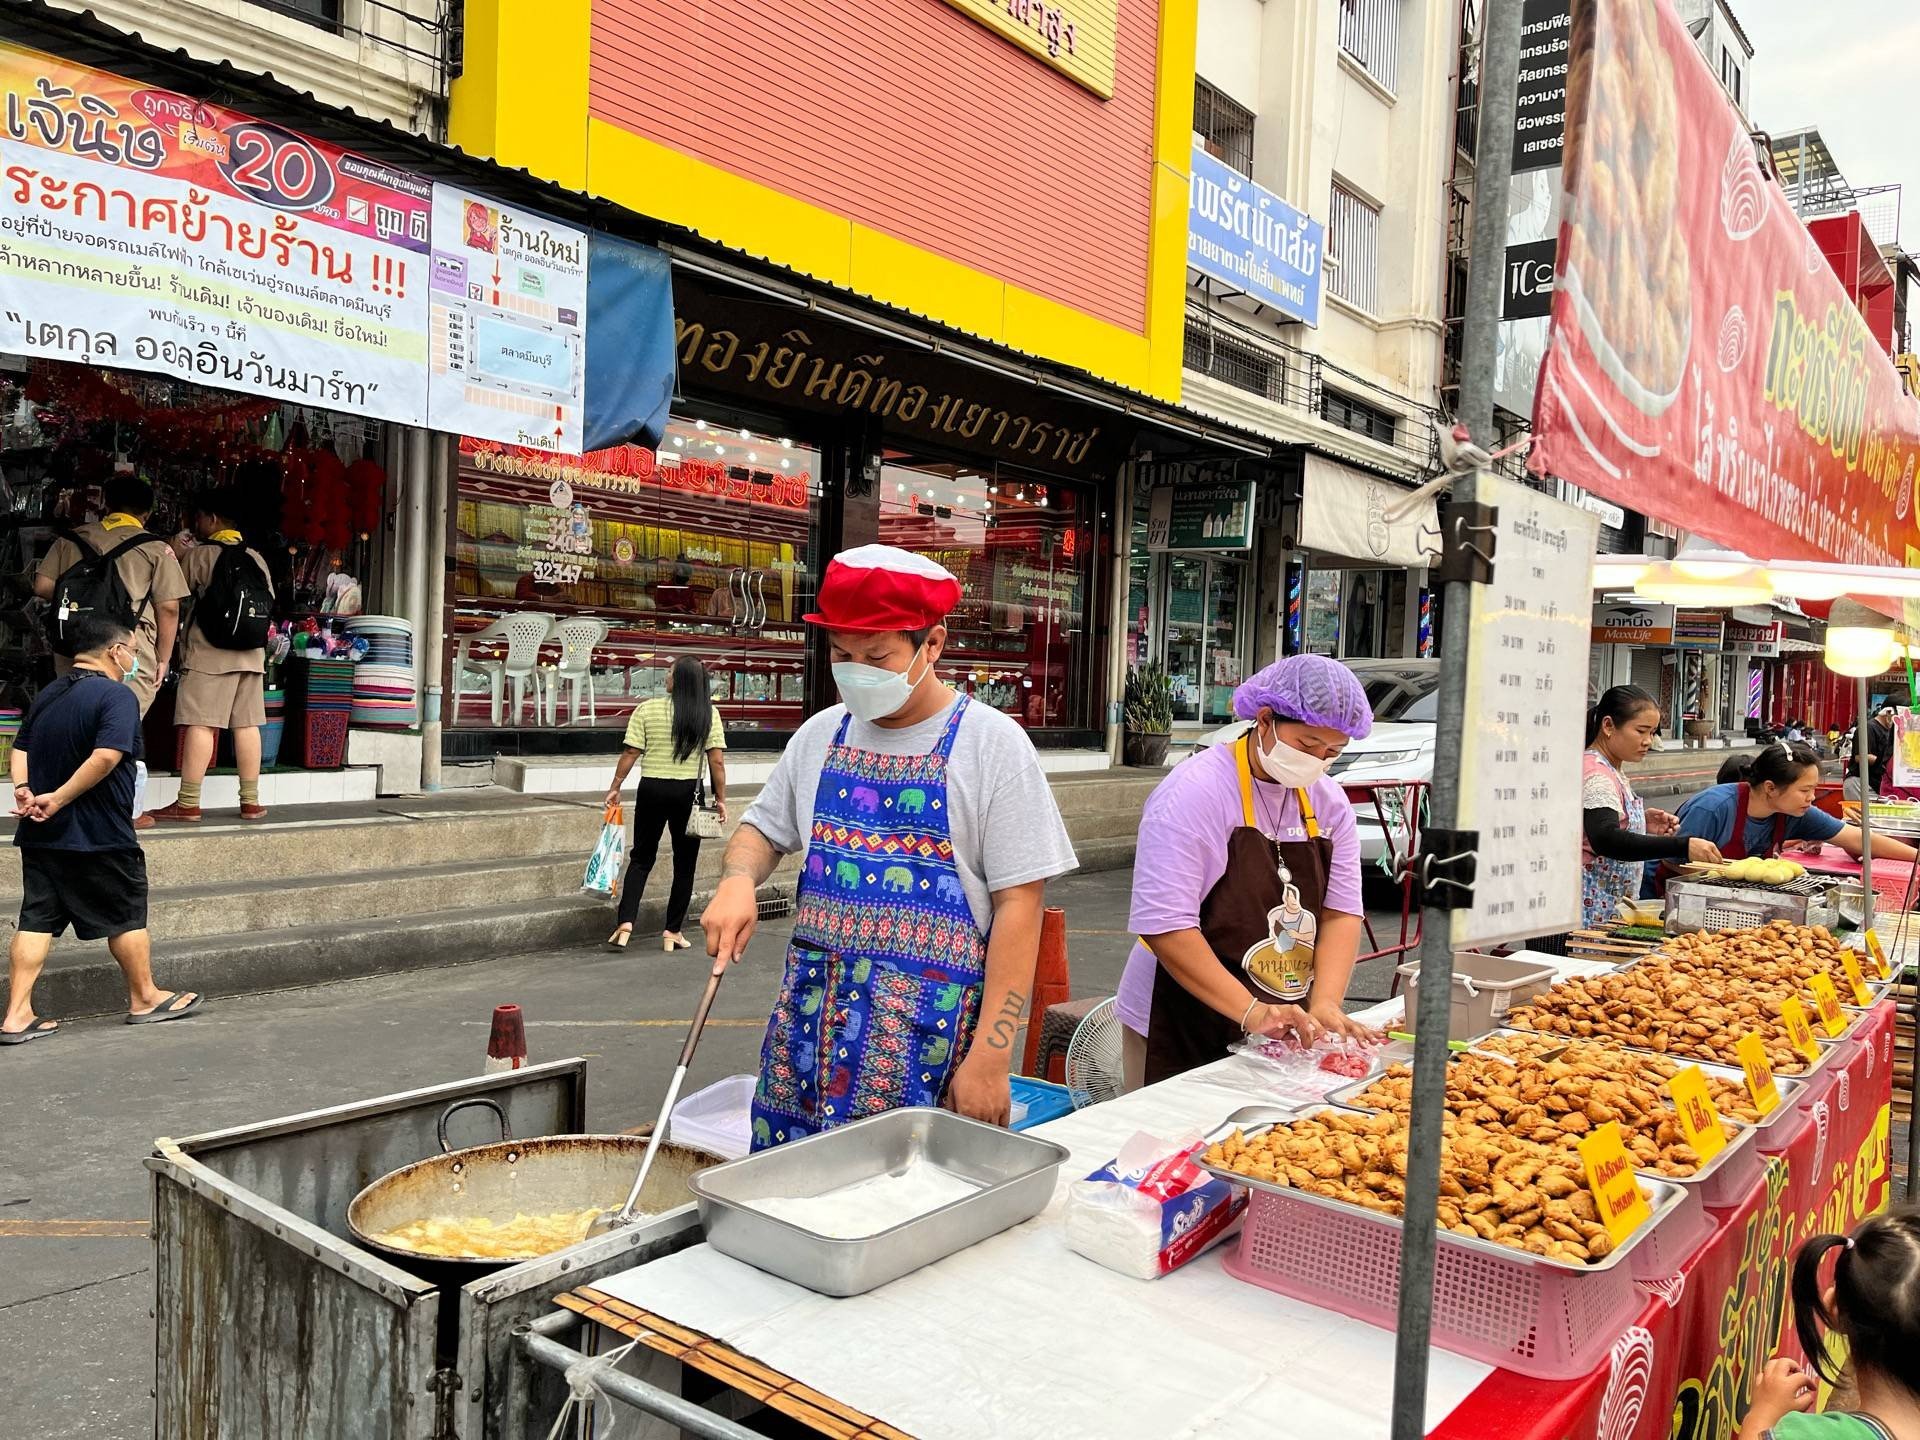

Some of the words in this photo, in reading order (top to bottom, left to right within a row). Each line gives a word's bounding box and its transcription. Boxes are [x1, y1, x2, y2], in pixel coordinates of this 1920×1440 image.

[1520, 38, 1570, 59] แกรมร้อ
[234, 129, 317, 200] 20
[5, 166, 352, 285] ระกาศย้ายร้าน
[373, 254, 406, 299] !!!
[376, 205, 404, 239] ถูก
[411, 210, 428, 241] ดี
[500, 214, 581, 265] ร้านใหม่
[501, 345, 552, 367] ตลาดมีนบุรี
[517, 430, 555, 449] ร้านเดิม
[1605, 613, 1653, 627] ยาหนึ่ง
[1604, 630, 1651, 641] MaxxLife
